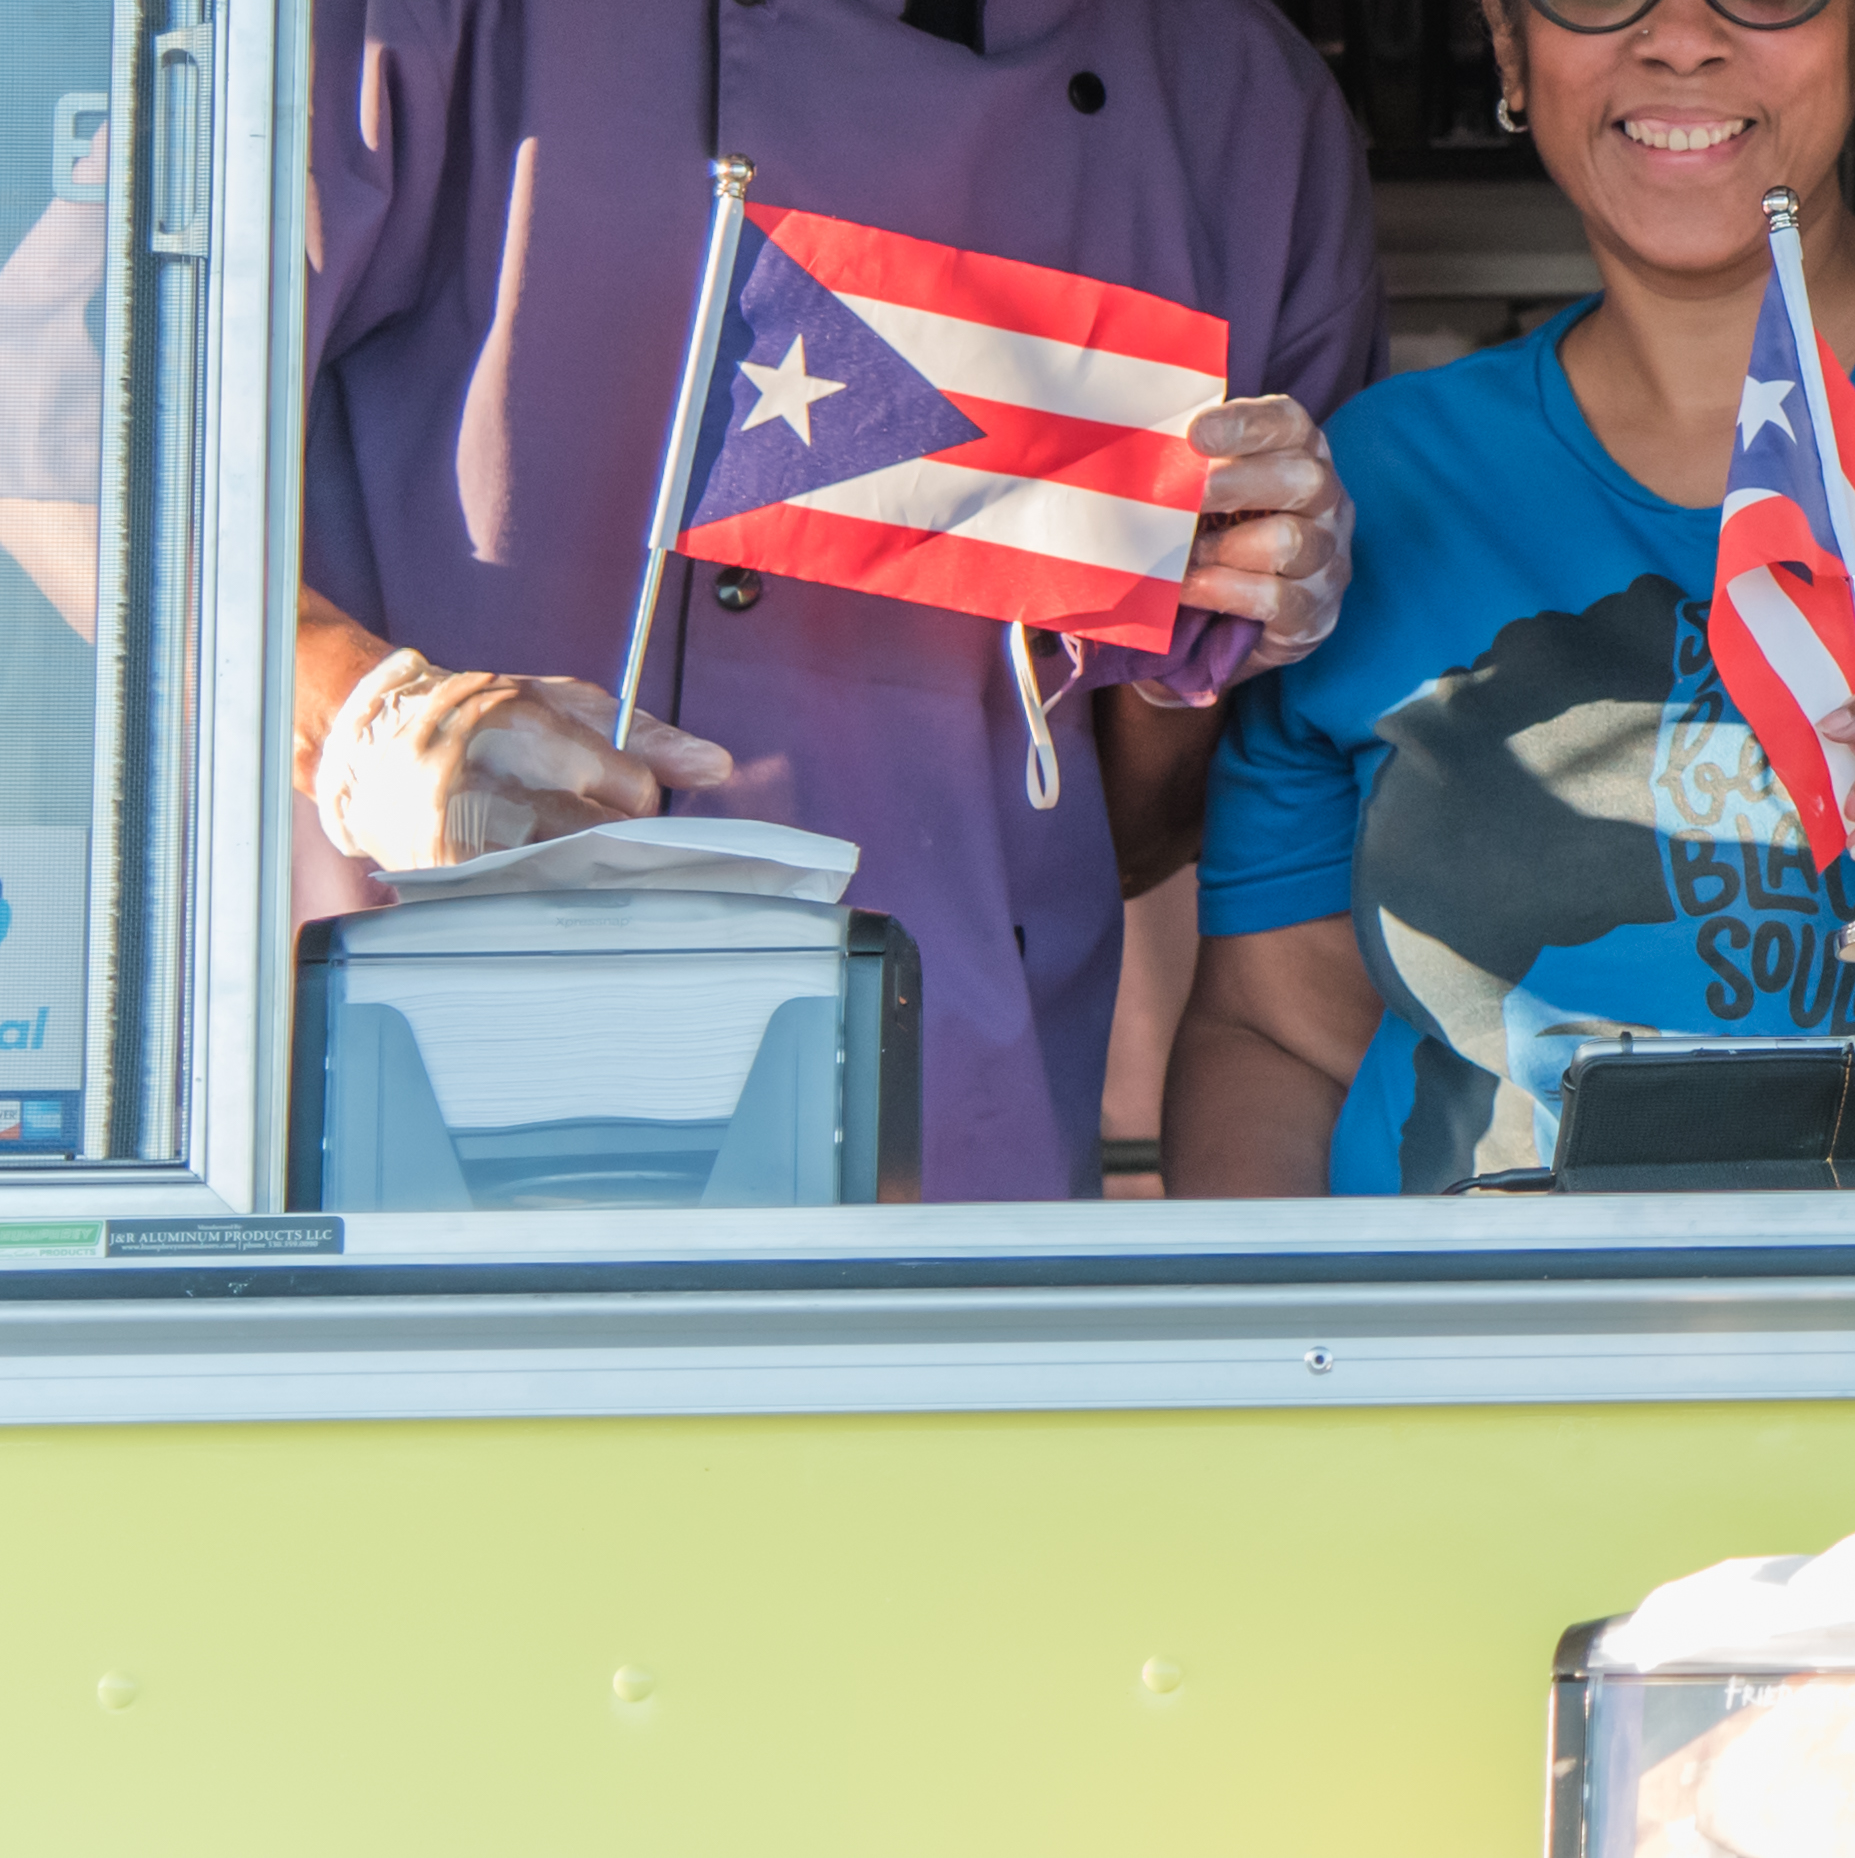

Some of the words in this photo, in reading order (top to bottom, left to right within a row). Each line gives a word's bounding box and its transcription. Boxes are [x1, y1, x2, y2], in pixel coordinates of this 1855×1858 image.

[109, 1231, 135, 1246] J&R
[139, 1230, 220, 1243] ALUMINUM
[224, 1229, 302, 1242] PRODUCTS
[306, 1228, 333, 1241] LLC
